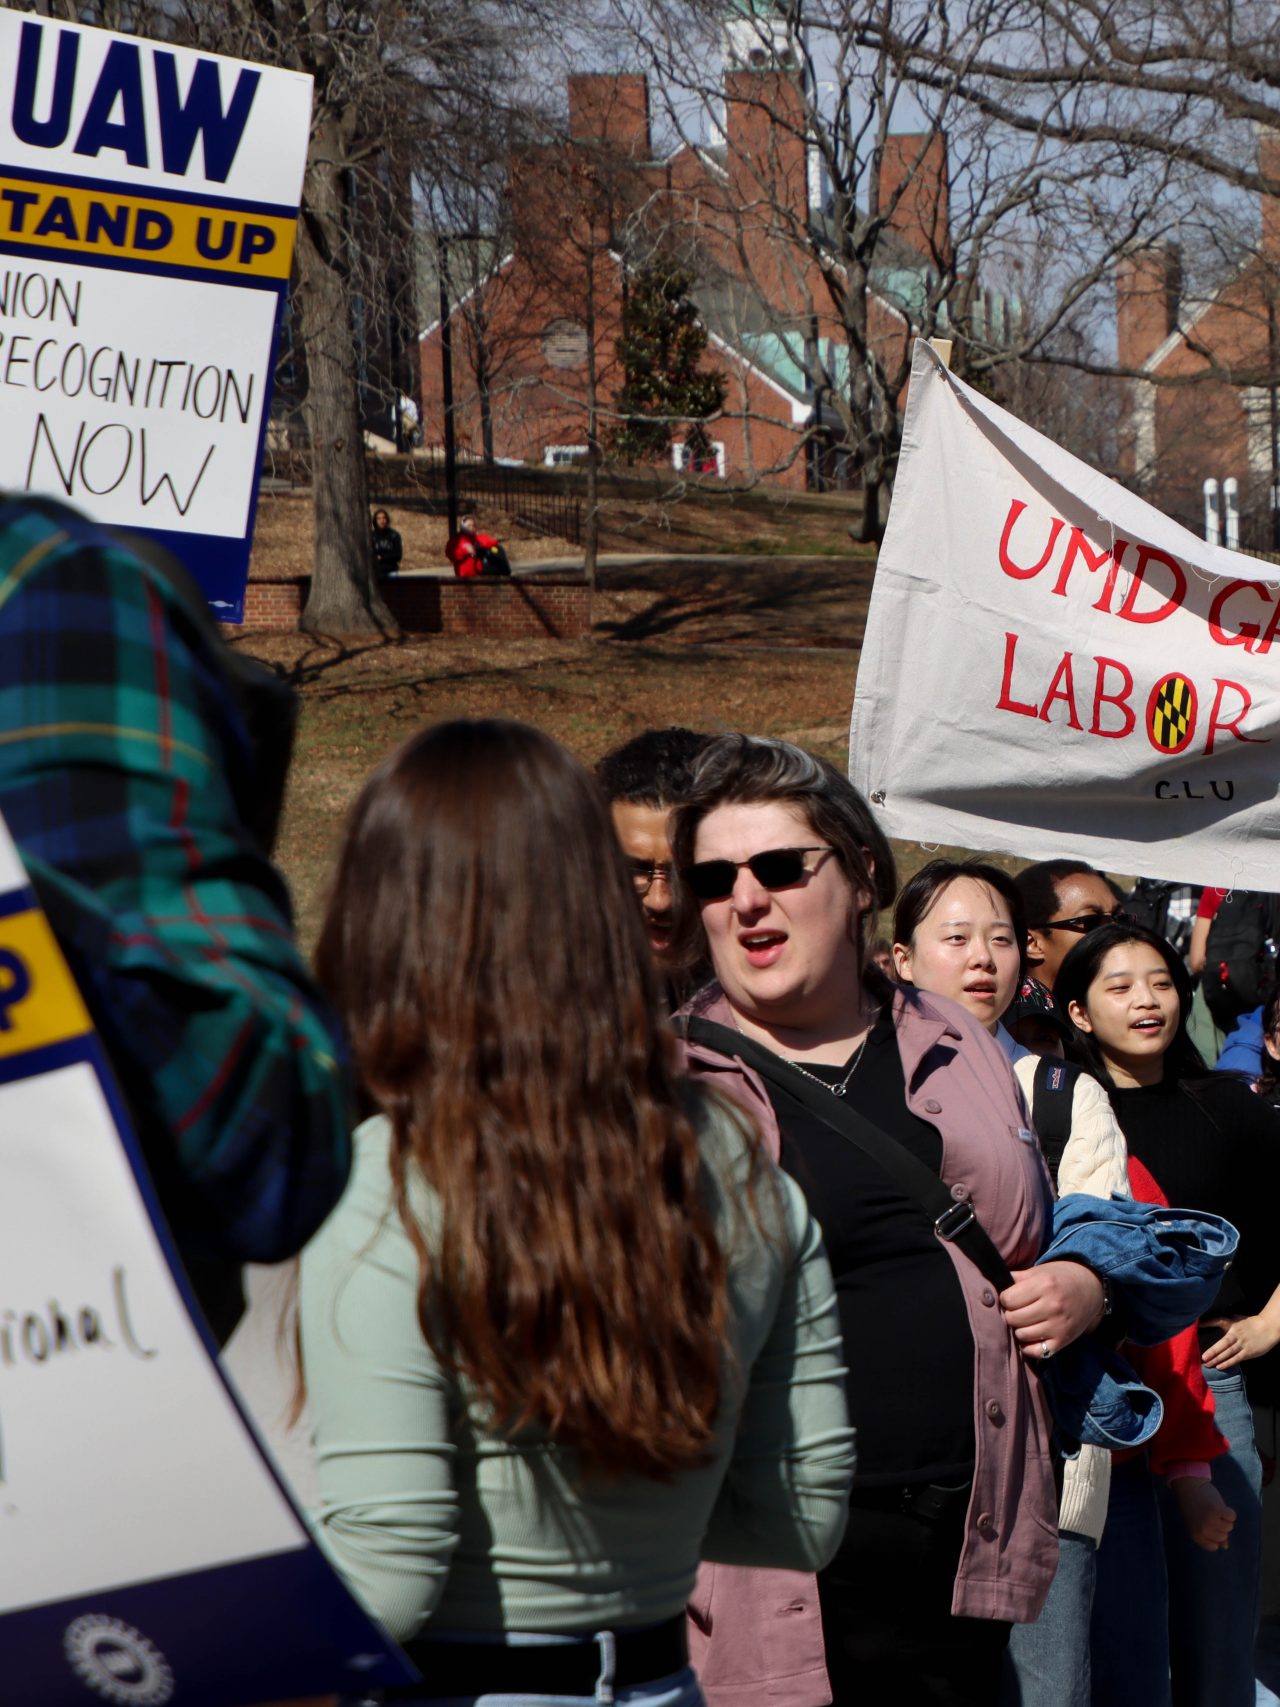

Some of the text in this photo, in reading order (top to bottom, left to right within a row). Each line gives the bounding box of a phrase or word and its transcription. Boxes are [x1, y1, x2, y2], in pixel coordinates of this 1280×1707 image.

[11, 20, 262, 184] UAW
[1, 188, 276, 266] TAND UP
[0, 330, 254, 424] ECOGNITION
[25, 412, 216, 517] NOW
[998, 499, 1187, 624] UMD
[995, 632, 1270, 756] LABOR
